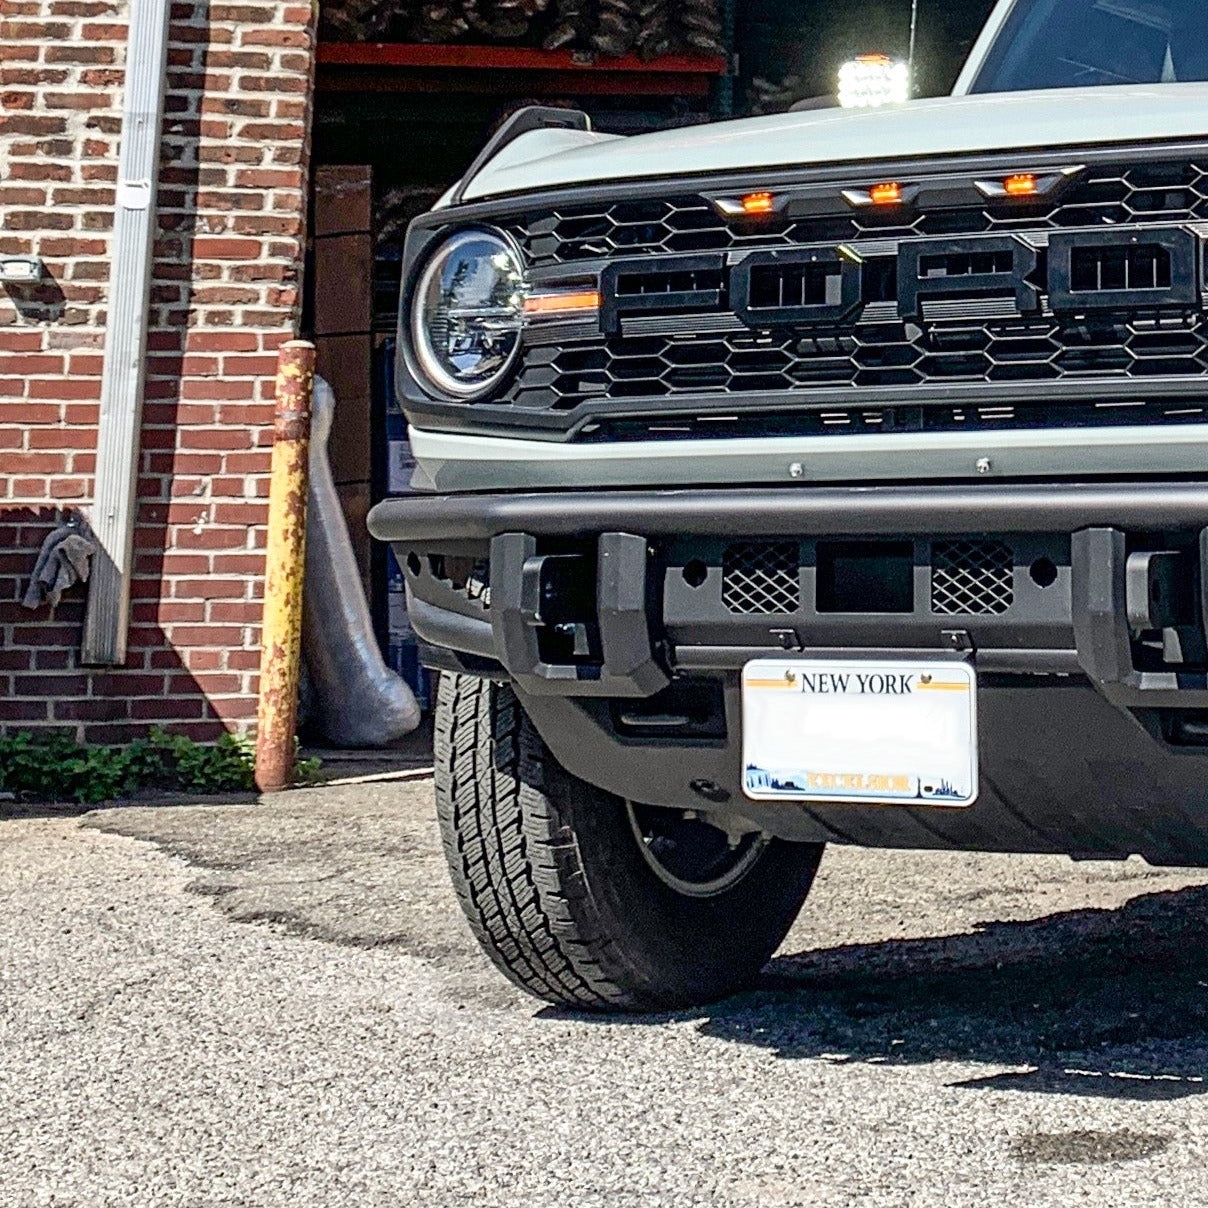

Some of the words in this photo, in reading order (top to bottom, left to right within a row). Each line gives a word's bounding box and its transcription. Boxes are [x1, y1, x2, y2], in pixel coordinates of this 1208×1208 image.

[600, 225, 1202, 339] FORD
[801, 673, 851, 694] NEW
[856, 673, 915, 695] YORK
